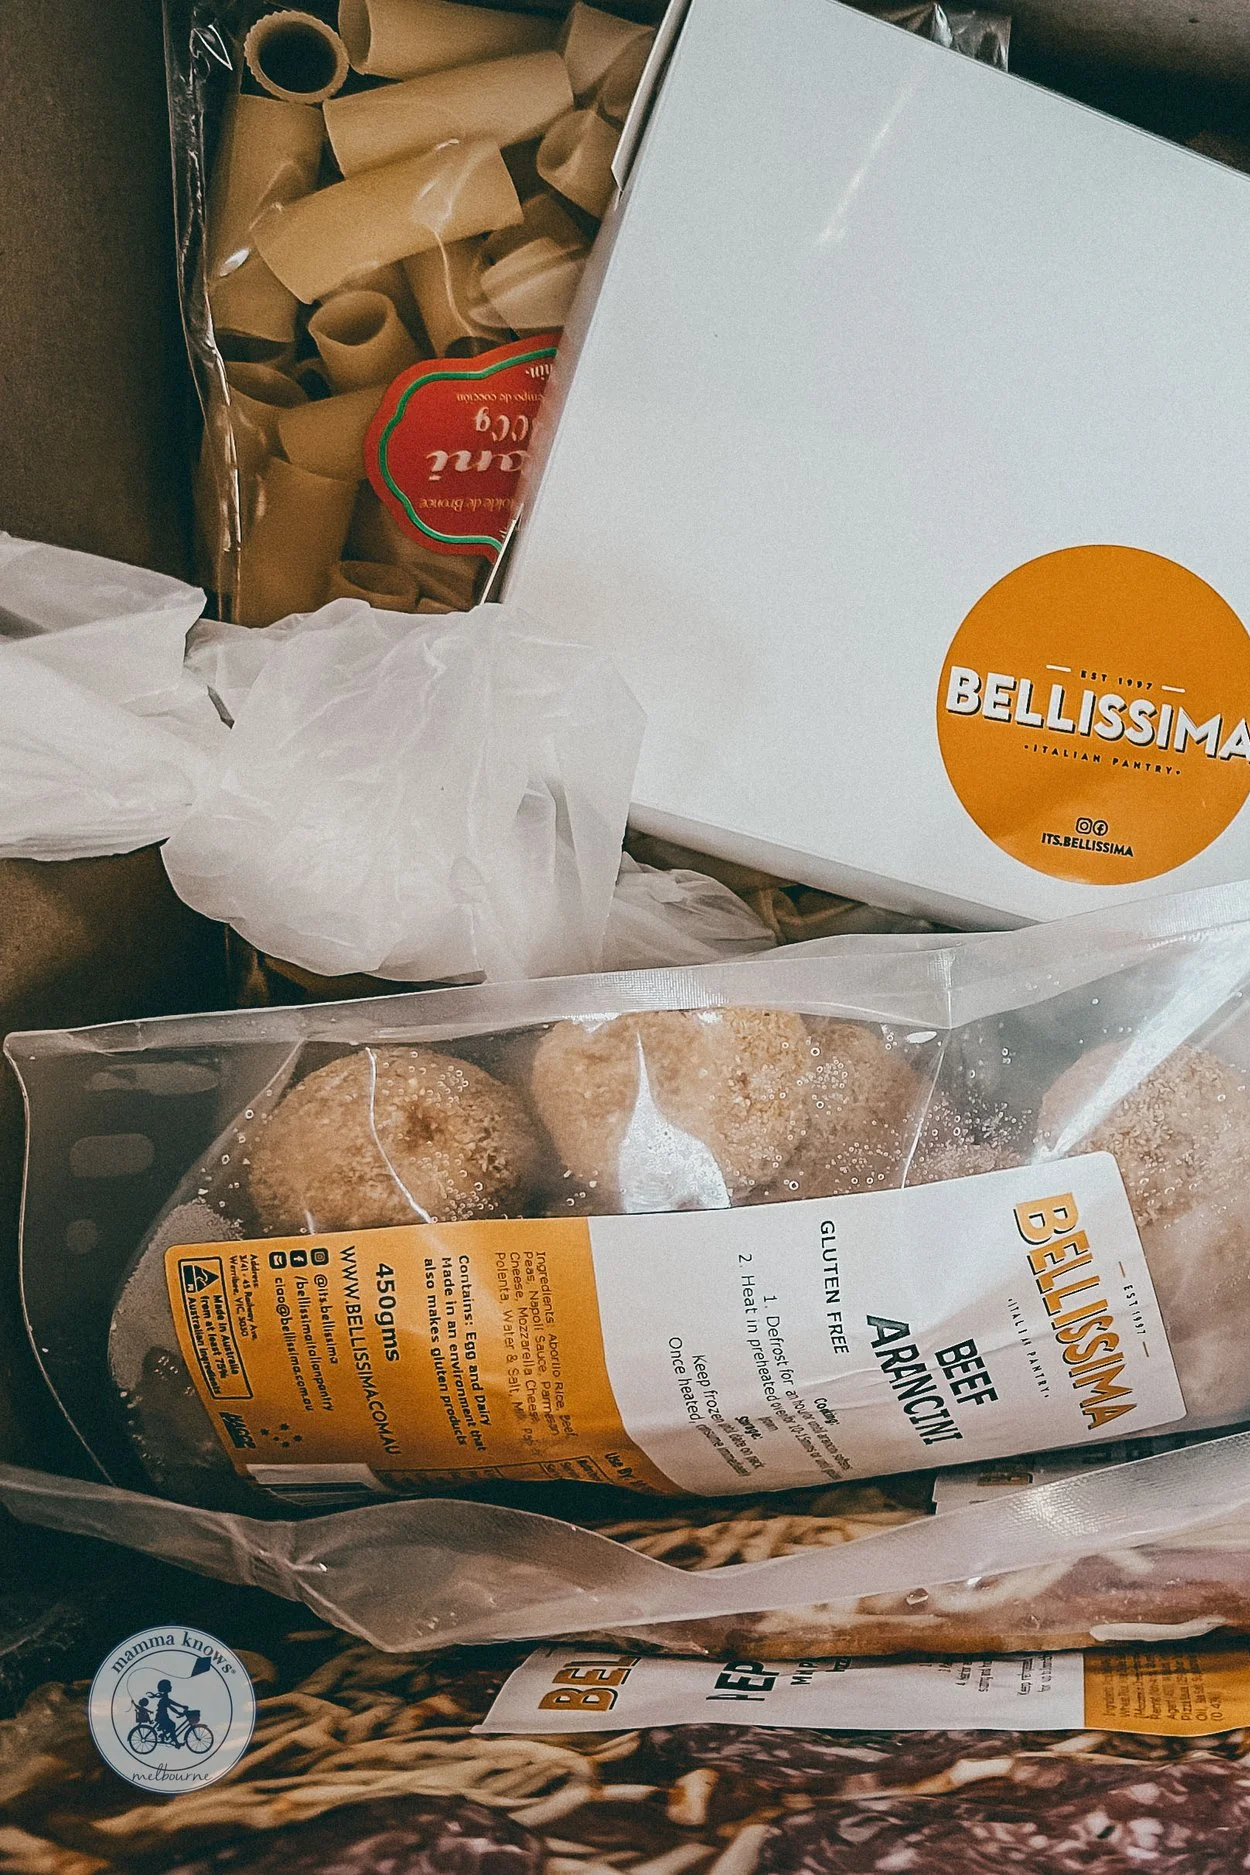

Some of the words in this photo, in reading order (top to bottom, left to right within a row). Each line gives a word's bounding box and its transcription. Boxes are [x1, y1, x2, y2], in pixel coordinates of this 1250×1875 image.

[456, 393, 497, 405] cocción
[513, 392, 544, 403] empo
[419, 498, 464, 512] Bronce
[469, 498, 482, 512] de
[481, 498, 514, 512] olde
[1080, 670, 1108, 683] EST
[1118, 676, 1153, 690] 1997
[1033, 743, 1101, 763] ITALIAN
[1111, 757, 1173, 776] PANTRY
[1041, 832, 1135, 858] ITS.BELLISSIMA
[424, 1258, 437, 1289] also
[441, 1257, 455, 1296] Made
[494, 1252, 510, 1304] Polenta,
[509, 1252, 526, 1302] Cheese,
[522, 1251, 535, 1285] Peas,
[739, 1253, 753, 1268] 2.
[820, 1220, 841, 1304] GLUTEN
[200, 1295, 212, 1319] from
[244, 1291, 256, 1323] Railway
[445, 1300, 457, 1316] in
[458, 1255, 476, 1326] Contains:
[741, 1275, 759, 1314] Heat
[763, 1295, 778, 1309] 1.
[1122, 1283, 1139, 1308] EST
[187, 1296, 206, 1346] Australian
[205, 1320, 215, 1332] at
[313, 1273, 340, 1365] @its.bellissima
[374, 1262, 401, 1362] 450gms
[427, 1295, 442, 1343] makes
[447, 1320, 458, 1339] an
[501, 1309, 518, 1350] Water
[527, 1290, 544, 1331] Napoli
[747, 1319, 759, 1333] in
[1013, 1192, 1138, 1430] BELLISSIMA
[1130, 1309, 1146, 1336] 1997
[207, 1333, 221, 1356] least
[213, 1294, 225, 1321] Made
[221, 1334, 240, 1375] Australia
[274, 1277, 315, 1412] ciao@bellissima.com.au
[294, 1275, 335, 1411] /bellissimaitalianpantry
[340, 1245, 402, 1455] WWW.BELLISSIMA.COM.AU
[464, 1332, 477, 1361] Egg
[516, 1307, 536, 1376] Mozzarella
[765, 1315, 790, 1366] Defrost
[826, 1311, 850, 1354] FREE
[213, 1357, 229, 1379] 75%
[430, 1347, 450, 1392] gluten
[506, 1354, 518, 1363] &
[534, 1335, 549, 1377] Sauce,
[668, 1336, 687, 1375] Once
[746, 1339, 781, 1402] preheated
[934, 1338, 999, 1406] BEEF
[1026, 1350, 1049, 1394] PANTRY
[449, 1343, 478, 1428] environment
[469, 1365, 484, 1391] and
[507, 1367, 522, 1397] Salt,
[553, 1381, 565, 1411] Rice,
[691, 1354, 713, 1387] Keep
[702, 1390, 726, 1424] frozen
[779, 1369, 795, 1385] for
[785, 1390, 800, 1400] an
[866, 1313, 964, 1446] ARANCINI
[440, 1395, 468, 1446] products
[474, 1394, 492, 1426] Dairy
[540, 1381, 561, 1436] Parmesan
[677, 1378, 706, 1424] heated,
[470, 1429, 487, 1452] that
